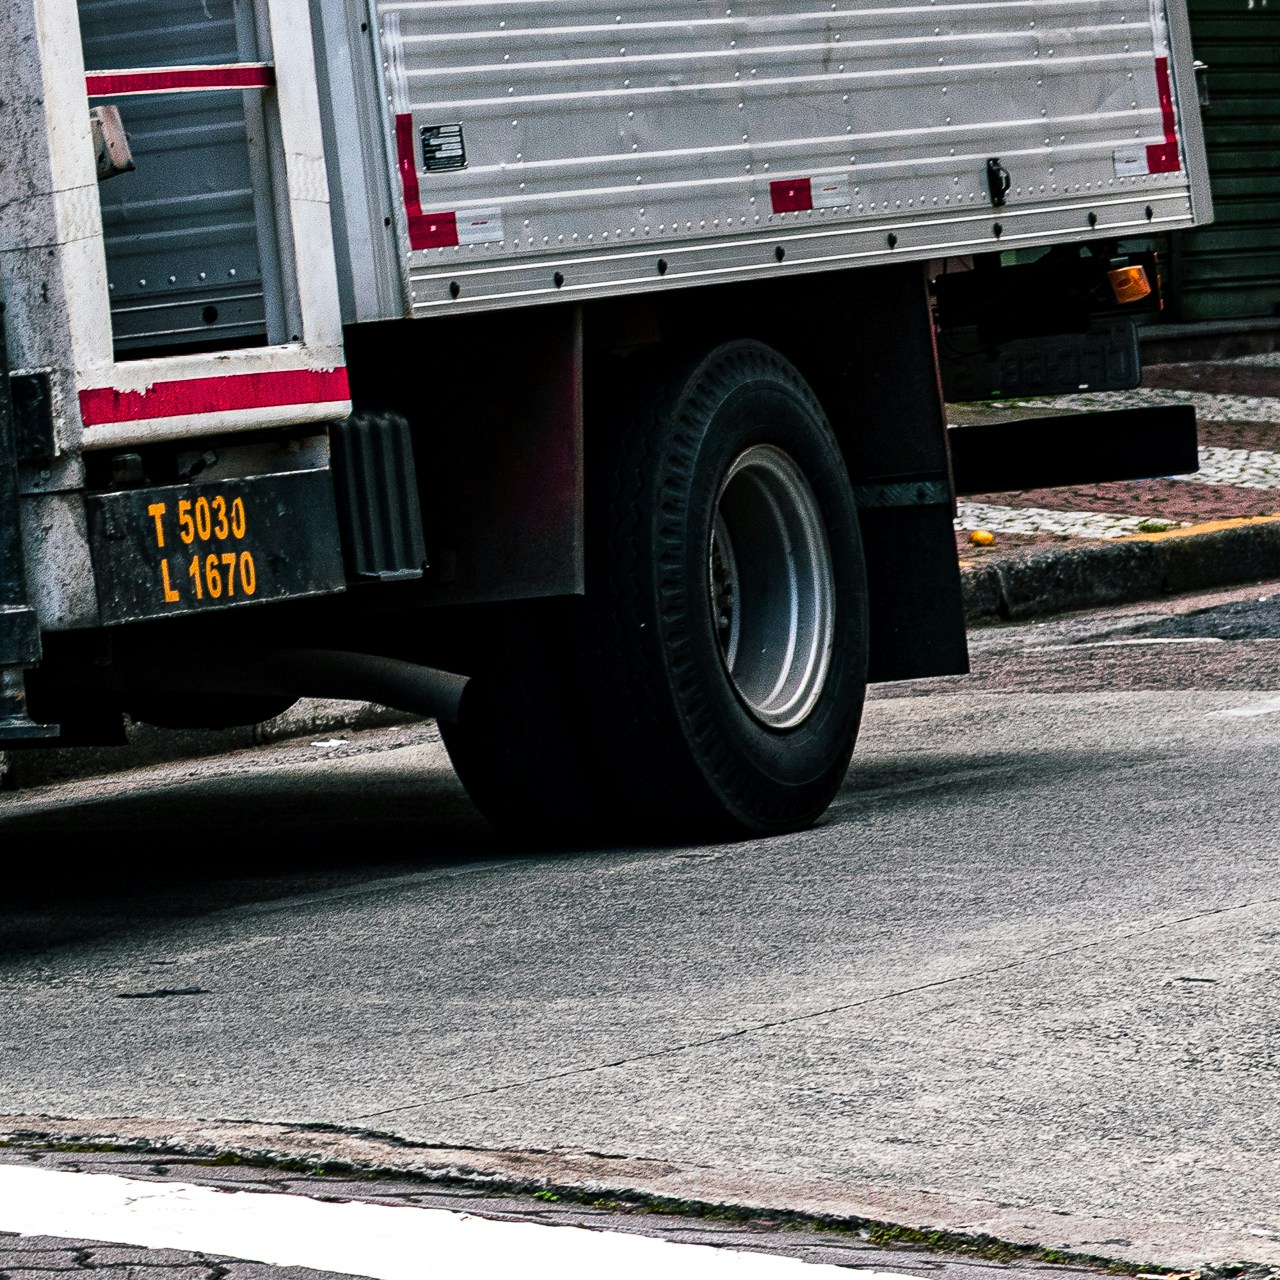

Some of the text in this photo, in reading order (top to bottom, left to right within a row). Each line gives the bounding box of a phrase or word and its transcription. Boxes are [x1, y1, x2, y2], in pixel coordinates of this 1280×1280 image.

[148, 495, 246, 548] T 5030
[160, 550, 256, 603] L 1670
